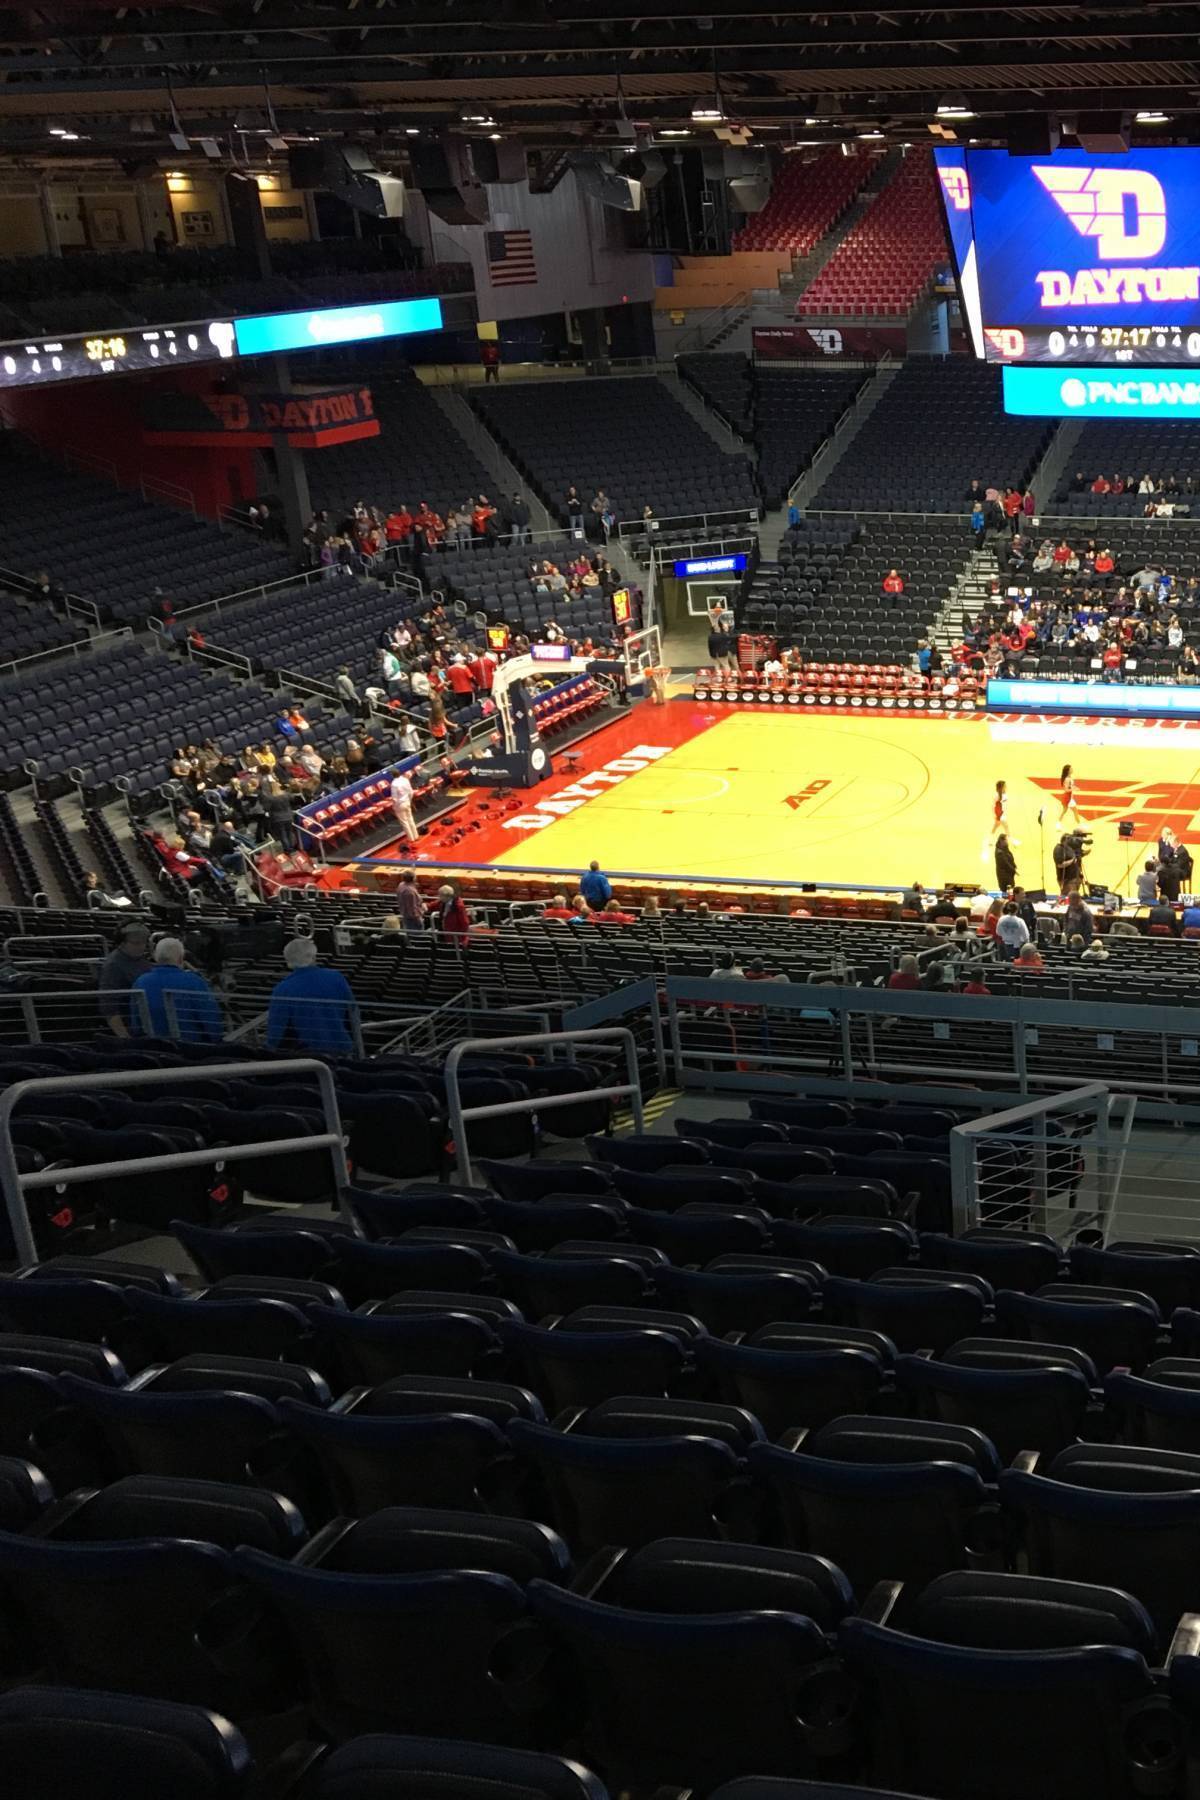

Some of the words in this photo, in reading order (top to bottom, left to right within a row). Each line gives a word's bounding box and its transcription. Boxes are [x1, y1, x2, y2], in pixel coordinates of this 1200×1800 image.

[1035, 267, 1200, 306] DAYTON
[1101, 327, 1151, 347] 37:17
[501, 745, 674, 829] DAYTON
